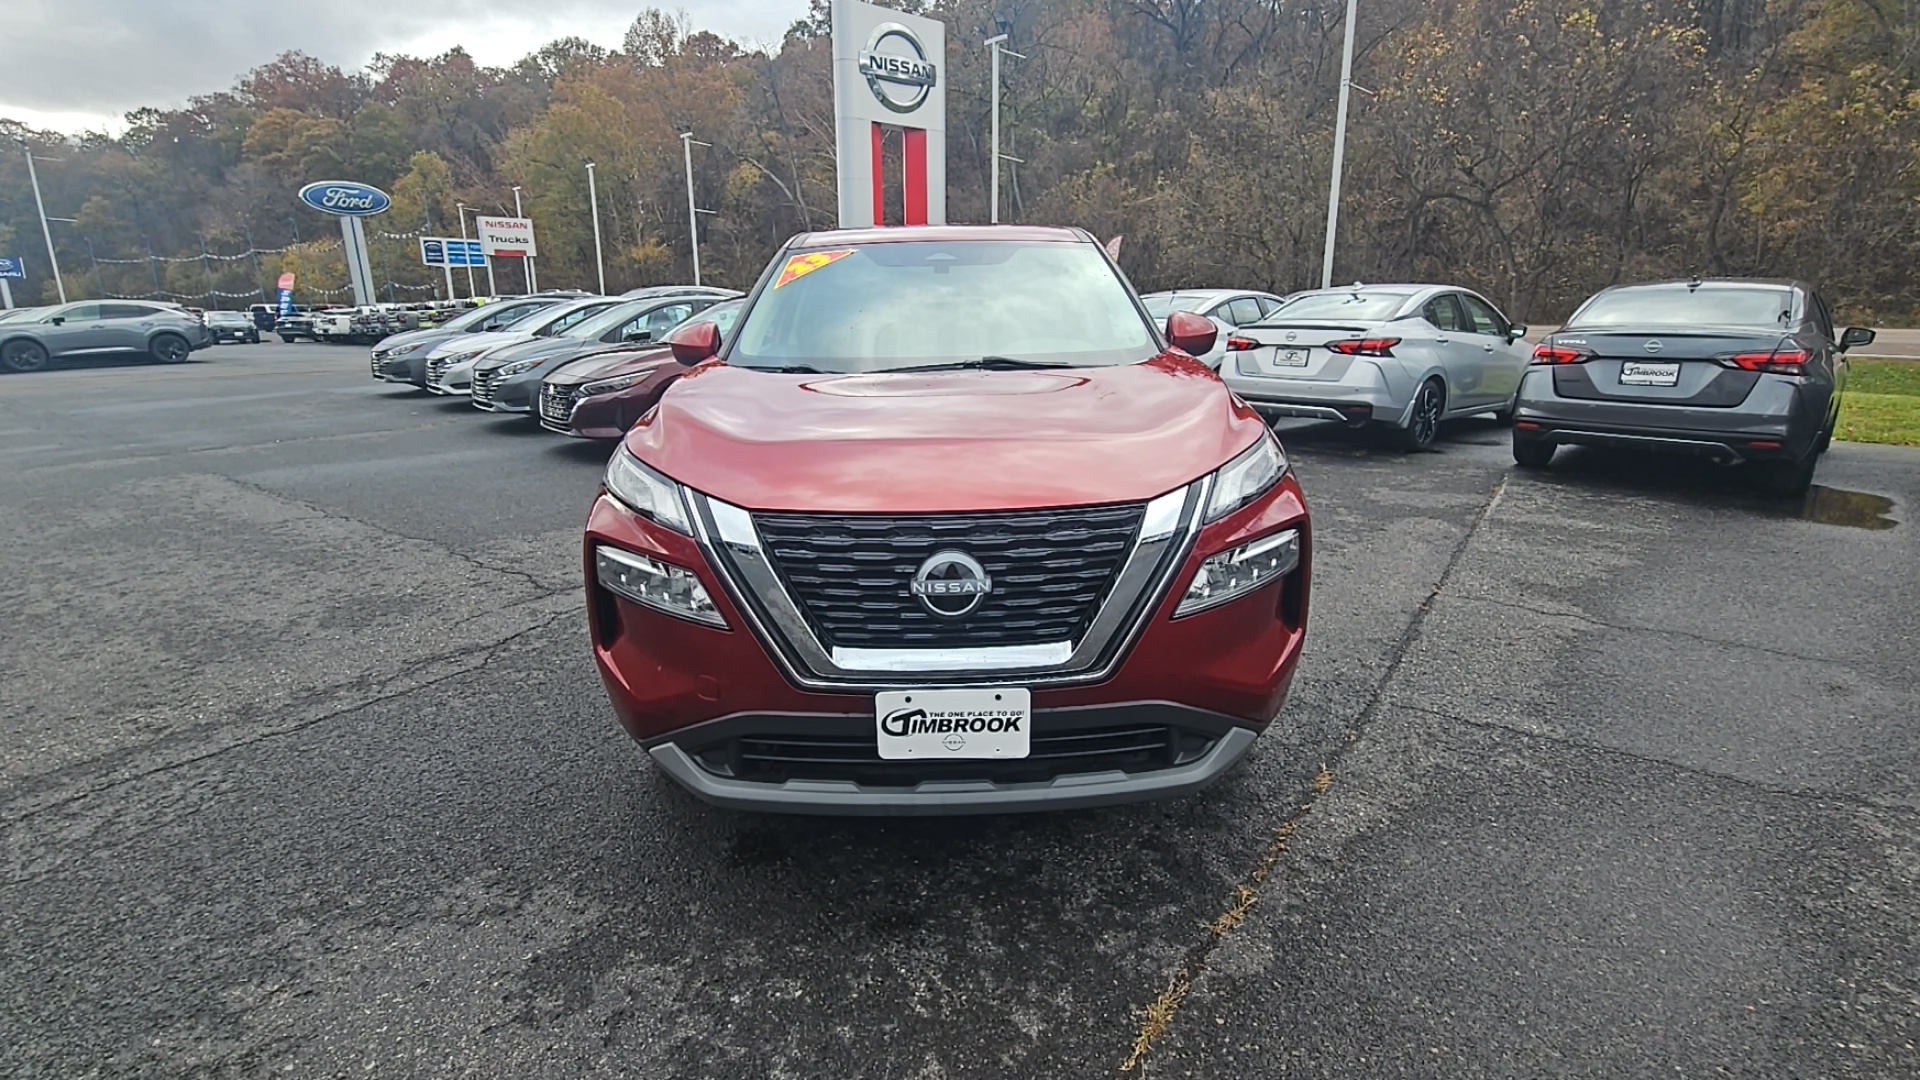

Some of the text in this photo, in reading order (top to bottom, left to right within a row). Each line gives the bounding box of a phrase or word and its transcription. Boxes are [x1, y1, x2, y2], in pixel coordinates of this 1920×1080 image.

[869, 55, 932, 79] NISSAN
[322, 187, 373, 209] Ford
[485, 220, 528, 230] NISSAN
[488, 234, 529, 244] Trucks
[787, 254, 831, 275] 23
[912, 582, 990, 593] NISSAN
[1010, 709, 1025, 717] GO!
[881, 708, 1023, 737] TIMBROOK
